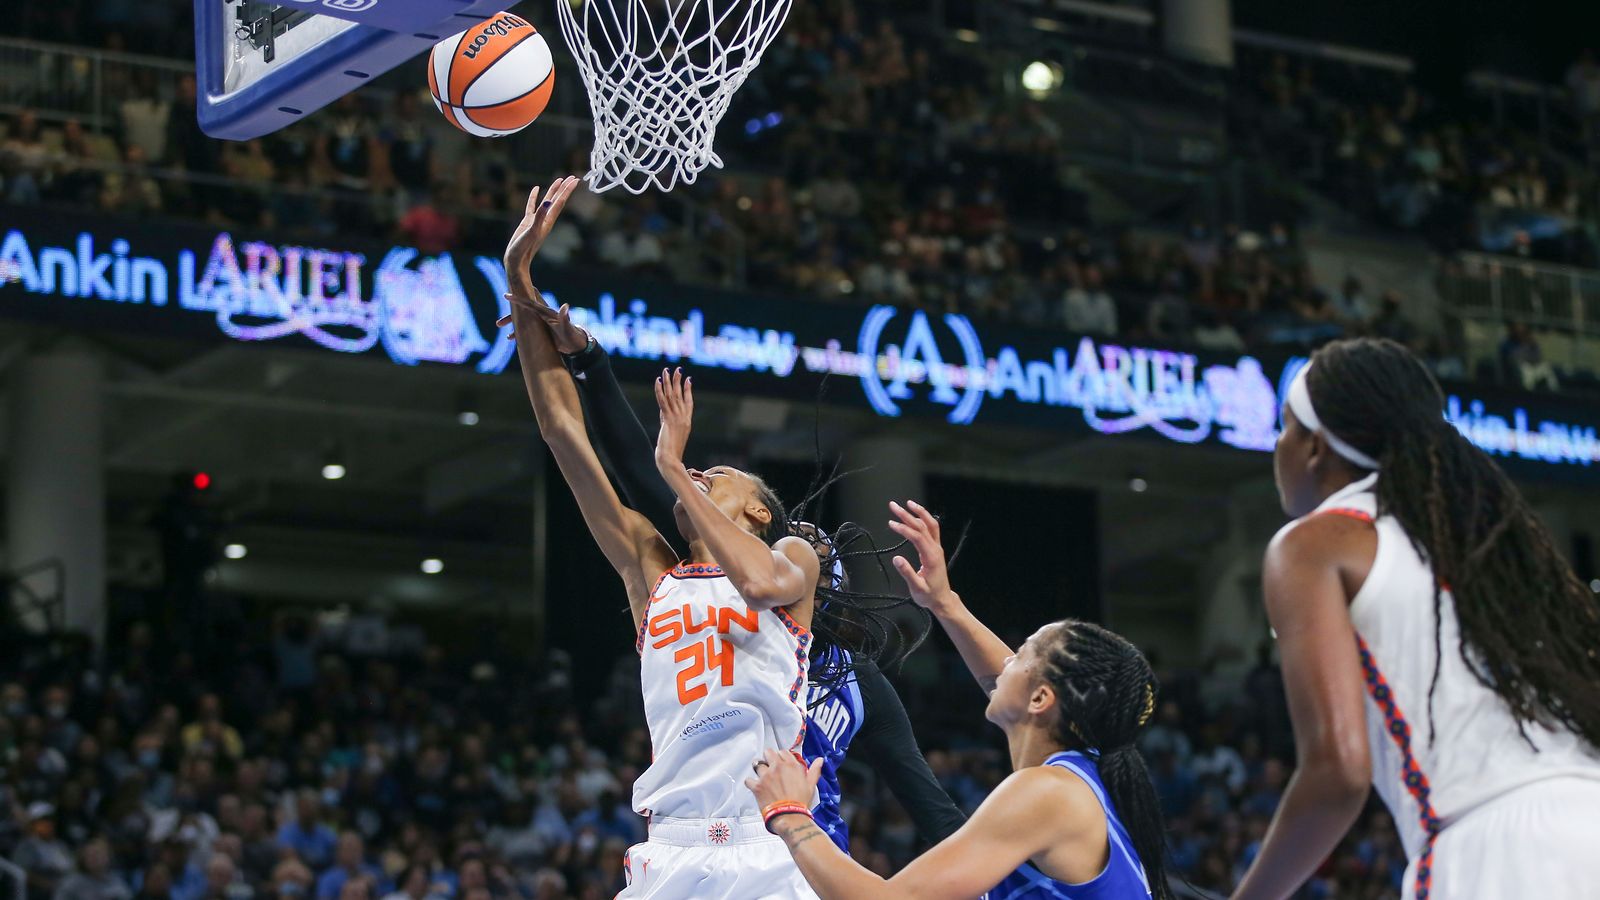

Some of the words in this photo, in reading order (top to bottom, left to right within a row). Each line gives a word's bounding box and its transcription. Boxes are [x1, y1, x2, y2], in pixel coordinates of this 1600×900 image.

[462, 15, 528, 60] Wilson
[0, 229, 168, 307] Ankin
[202, 232, 367, 308] ARIEL
[649, 603, 759, 649] SUN
[674, 636, 735, 706] 24
